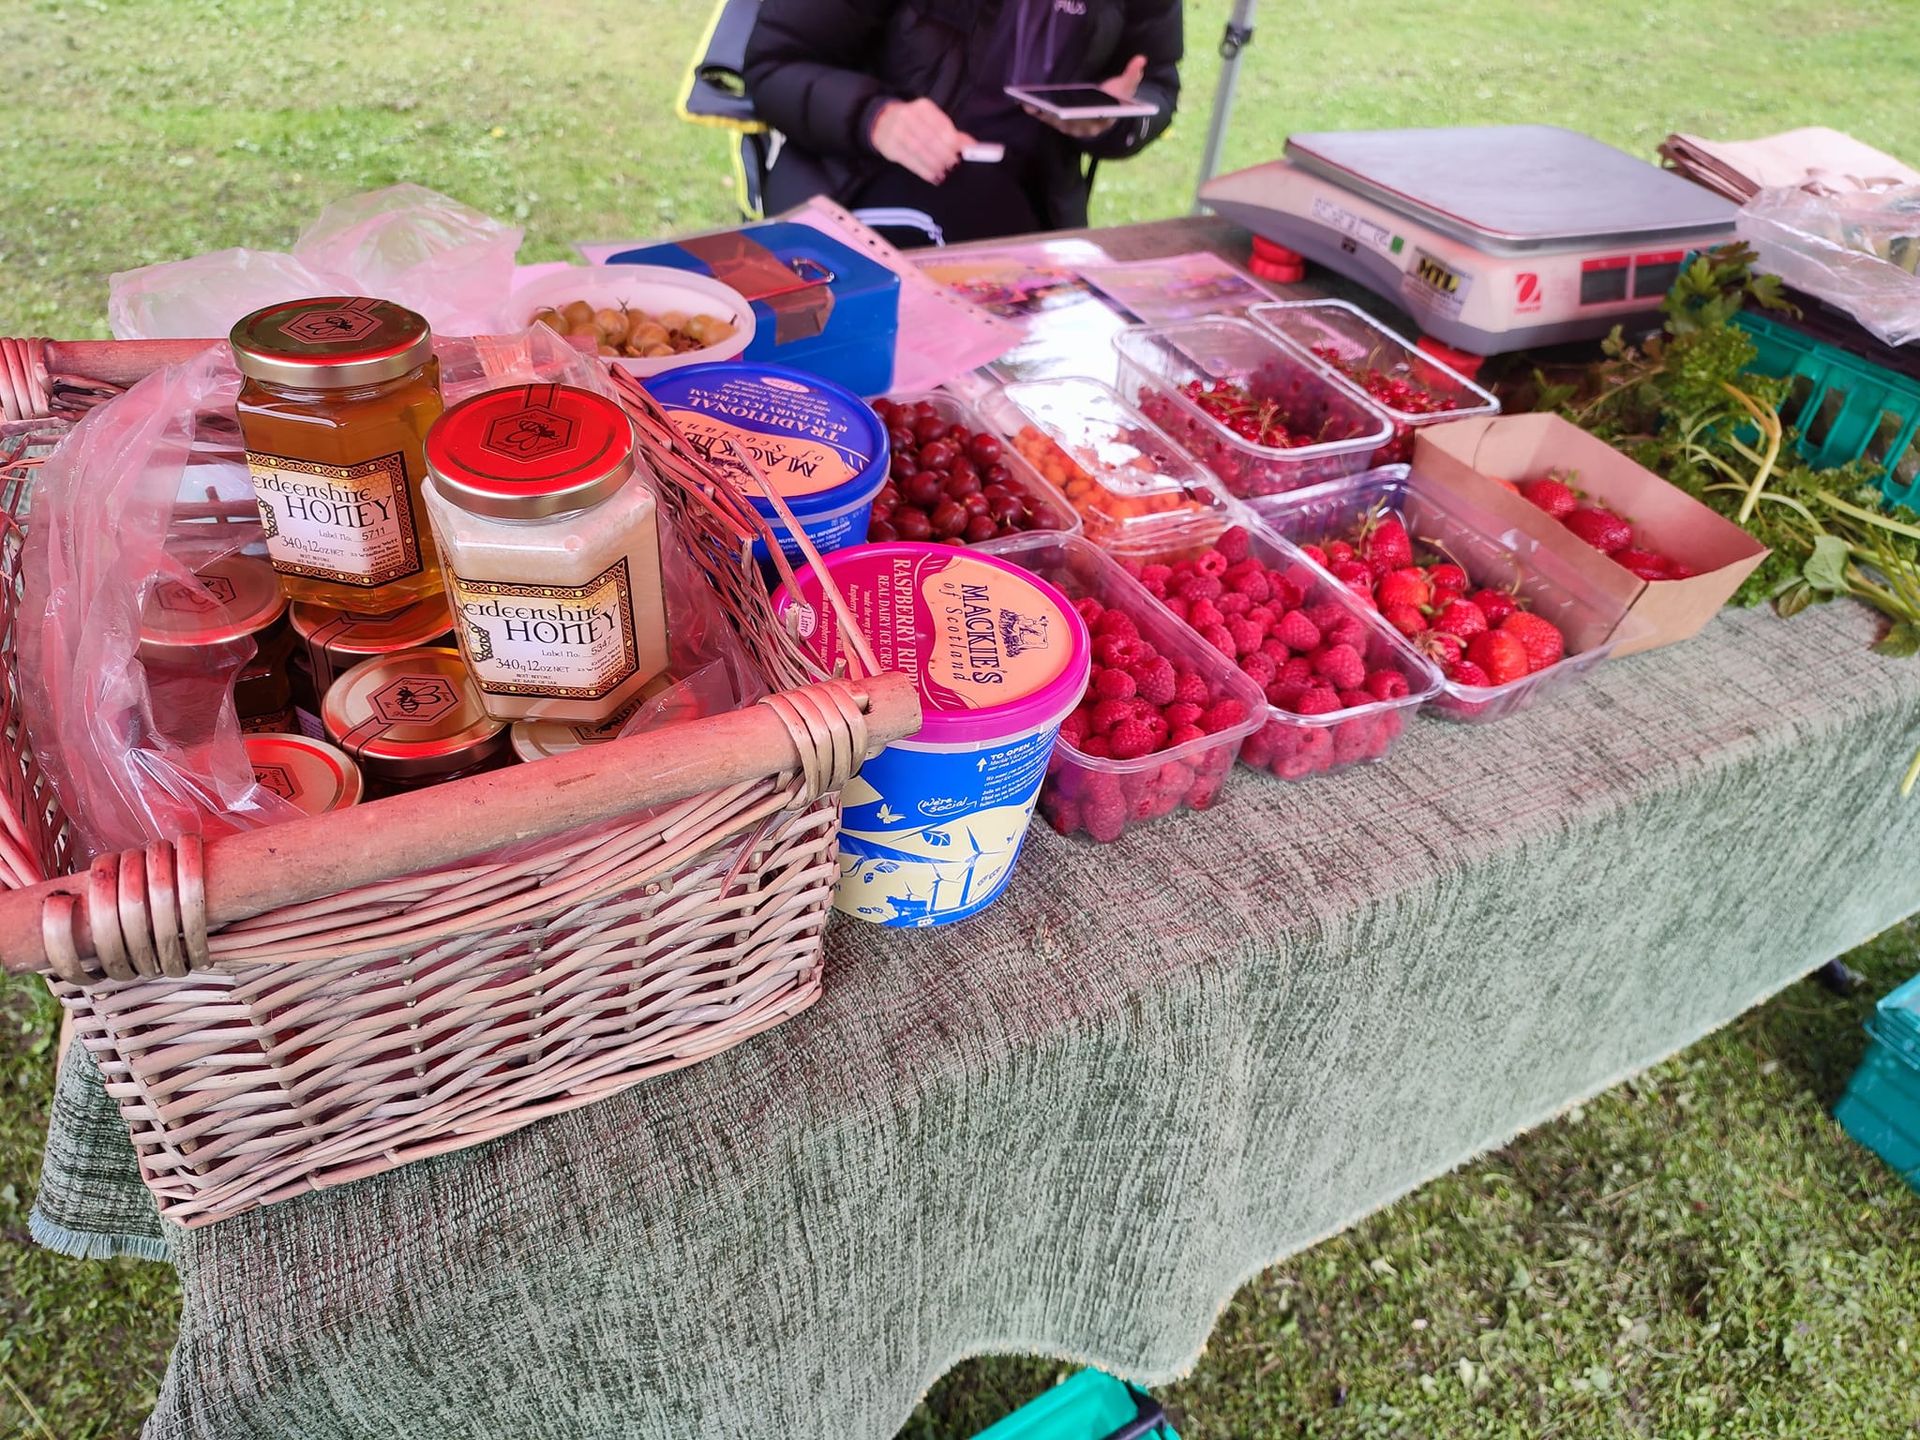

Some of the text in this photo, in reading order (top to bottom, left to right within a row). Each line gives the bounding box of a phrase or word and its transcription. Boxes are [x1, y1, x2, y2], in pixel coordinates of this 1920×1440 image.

[687, 395, 839, 443] TRADITIONAL
[689, 388, 848, 433] REAL DAIRY ICE CREAM
[800, 449, 824, 463] of
[361, 526, 387, 541] 5711
[463, 599, 602, 623] erdeenshire
[893, 558, 916, 643] RASPBERRY
[800, 615, 812, 633] Litre
[877, 574, 893, 673] REAL DAIRY ICE CREA
[938, 582, 972, 681] of Scotland
[960, 583, 1008, 684] MACKIE'S
[591, 635, 613, 656] 5347
[991, 752, 1004, 760] TO
[1005, 744, 1030, 757] OPEN
[929, 796, 968, 813] social
